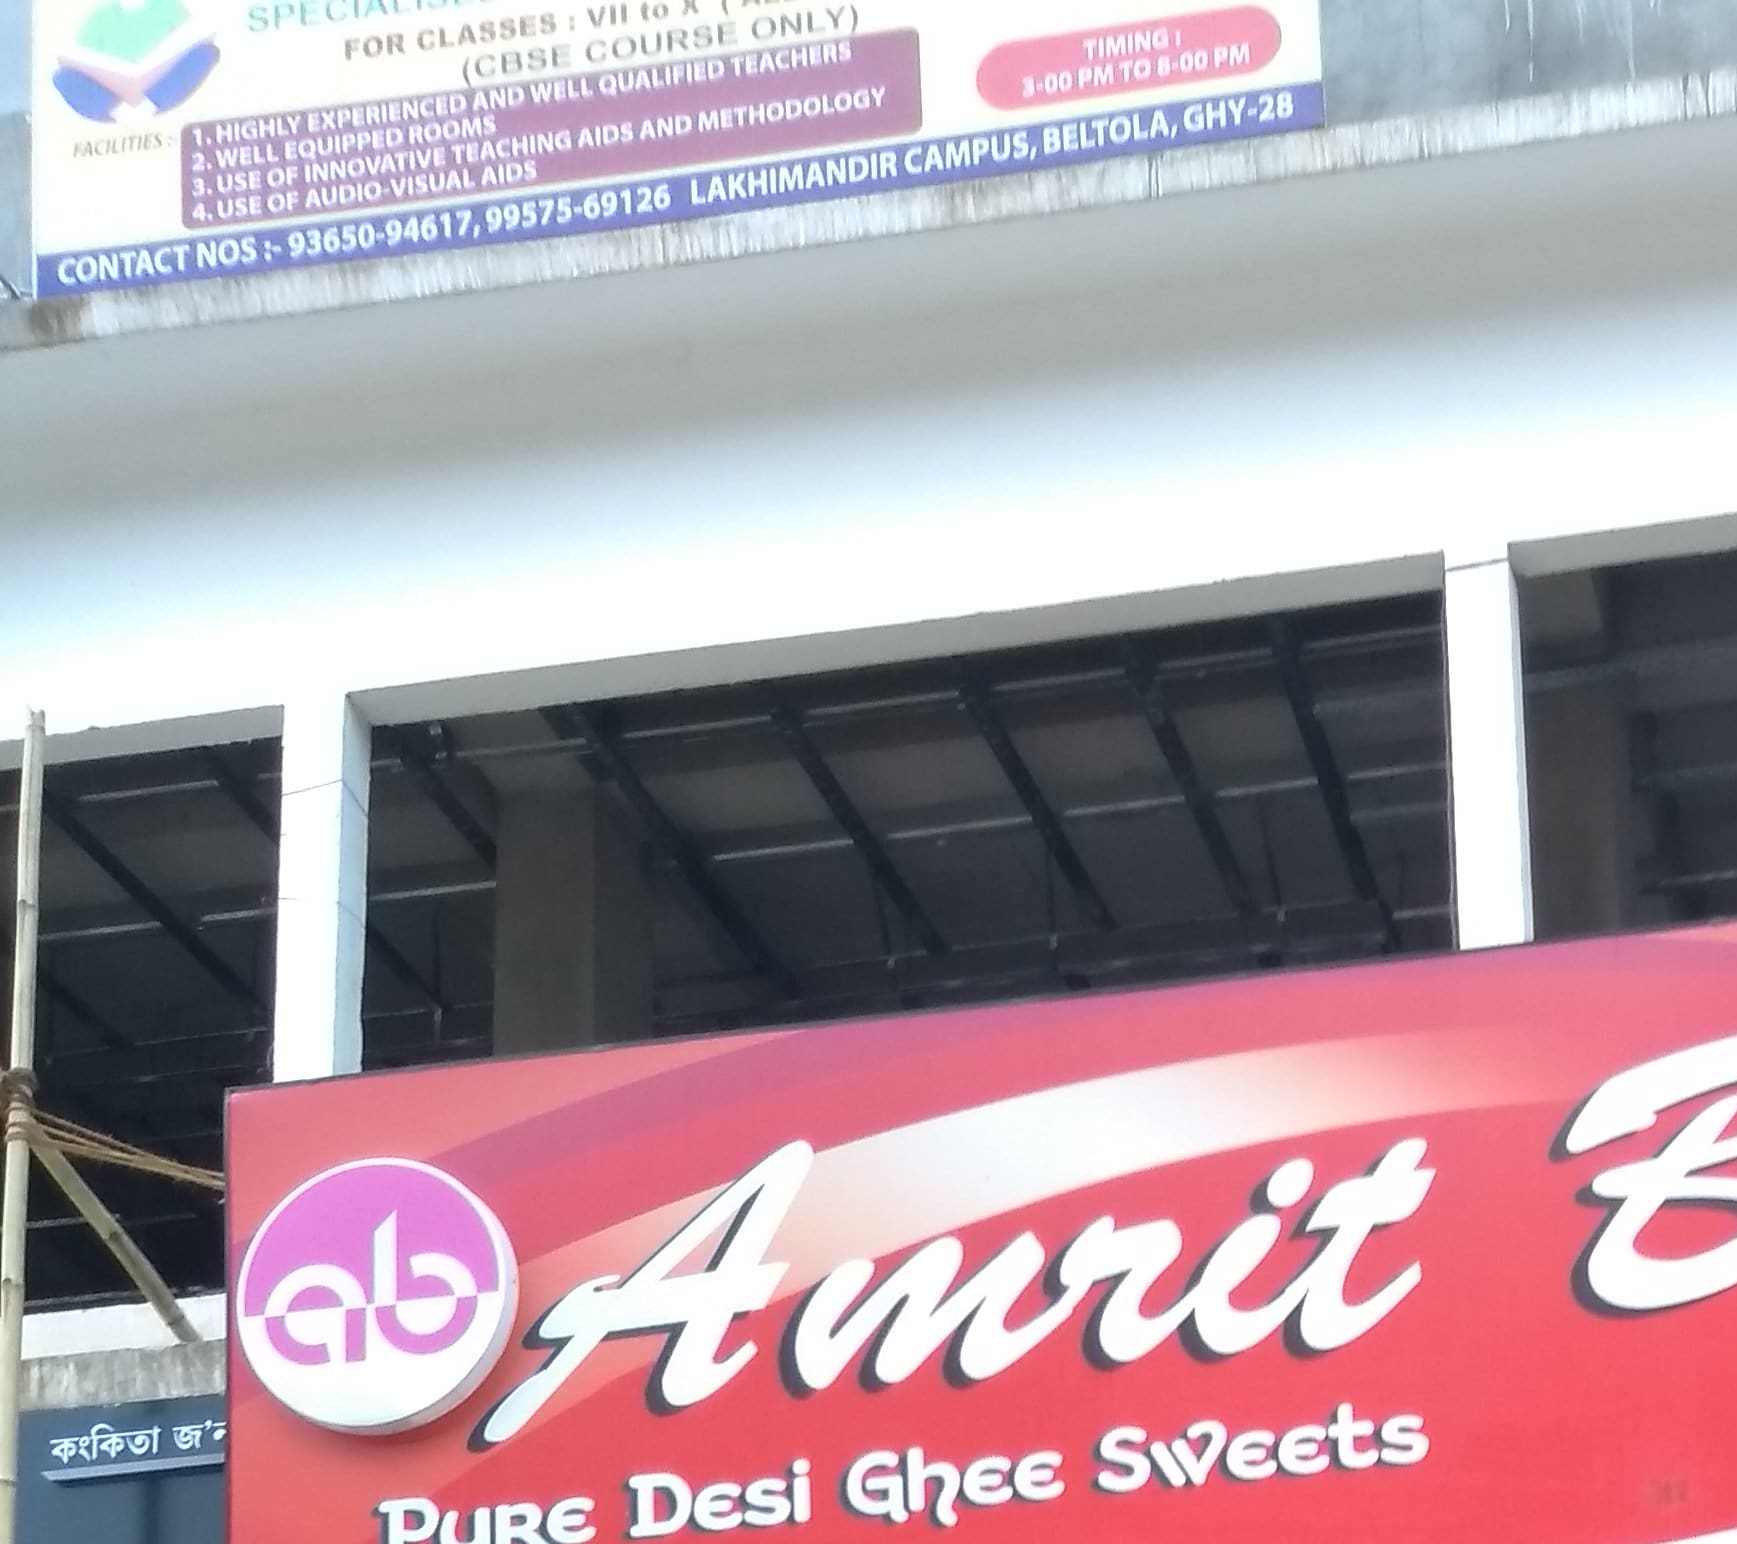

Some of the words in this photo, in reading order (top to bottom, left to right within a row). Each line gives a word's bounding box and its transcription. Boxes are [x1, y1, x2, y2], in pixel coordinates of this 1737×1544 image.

[343, 32, 406, 61] FOR
[416, 12, 557, 52] CLASSES
[587, 1, 628, 29] VII
[640, 0, 670, 21] to
[461, 45, 571, 88] (CBSE
[585, 21, 738, 64] COURSE
[751, 5, 859, 41] ONLY)
[1077, 64, 1114, 89] PM
[1118, 59, 1151, 80] TO
[1214, 43, 1250, 67] PM
[1083, 27, 1168, 61] TIMING
[215, 116, 301, 145] HIGHLY
[307, 92, 466, 133] EXPERIENCED
[472, 86, 525, 111] AND
[530, 78, 593, 103] WELL
[599, 63, 724, 96] QUALIFIED
[731, 42, 851, 77] TEACHERS
[215, 145, 279, 169] WELL
[285, 129, 403, 161] EQUIPPED
[408, 115, 497, 145] ROOMS
[217, 171, 261, 194] USE
[267, 168, 298, 187] OF
[304, 146, 445, 183] INNOVATIVE
[451, 131, 572, 164] TEACHING
[578, 122, 634, 148] AIDS
[639, 115, 692, 140] AND
[698, 87, 886, 132] METHODOLOGY
[57, 244, 189, 286] CONTACT
[196, 236, 257, 269] NOS
[288, 210, 480, 257] 93650-94617,
[485, 184, 672, 232] 99575-69126
[690, 150, 898, 206] LAKHIMANDIR
[904, 131, 1037, 176] CAMPUS,
[1043, 109, 1178, 155] BELTOLA,
[1183, 92, 1294, 132] GHY-28
[217, 195, 261, 219] USE
[267, 192, 298, 213] OF
[305, 169, 475, 209] AUDIO-VISUAL
[481, 161, 537, 186] AIDS
[478, 1137, 1437, 1448] Amrit
